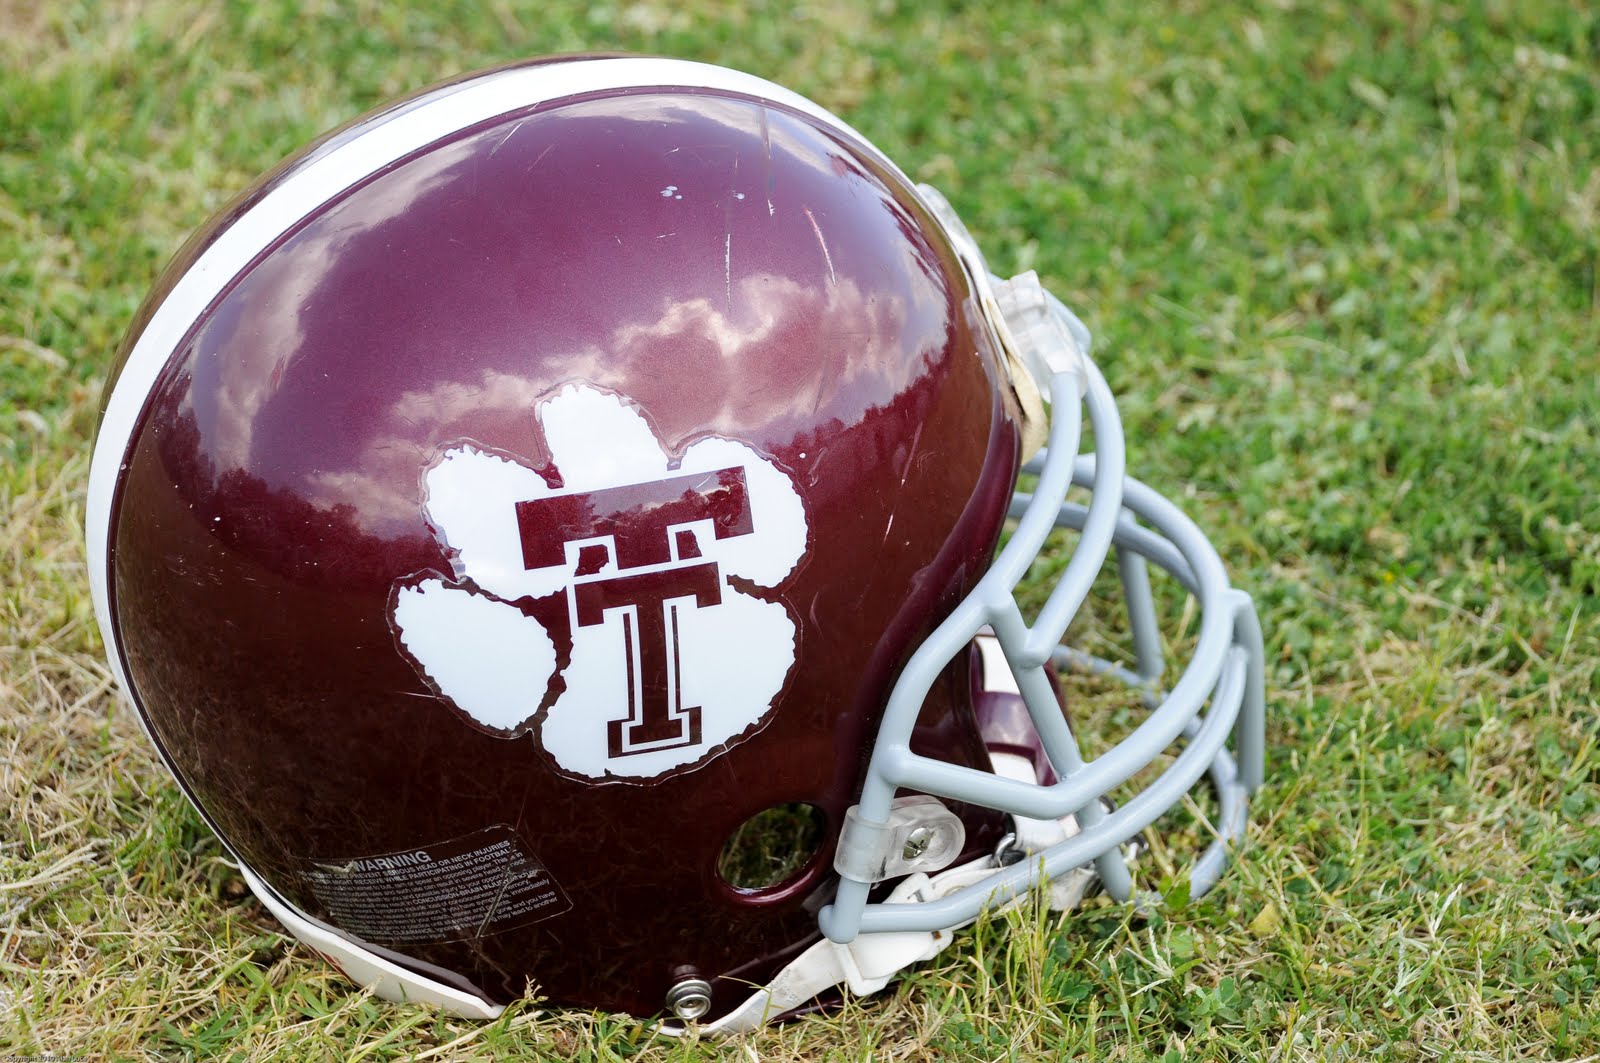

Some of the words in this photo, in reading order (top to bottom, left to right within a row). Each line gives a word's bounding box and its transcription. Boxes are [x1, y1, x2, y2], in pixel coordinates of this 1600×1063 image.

[574, 561, 723, 750] T
[348, 870, 381, 878] PREVENT
[382, 865, 415, 876] SERIOUS
[416, 860, 437, 871] HEAD
[438, 858, 450, 867] OR
[450, 851, 473, 863] NECK
[473, 840, 510, 857] INJURIES
[352, 851, 431, 872] WARNING
[384, 873, 408, 882] WHILE
[408, 861, 464, 879] PARTICIPATING
